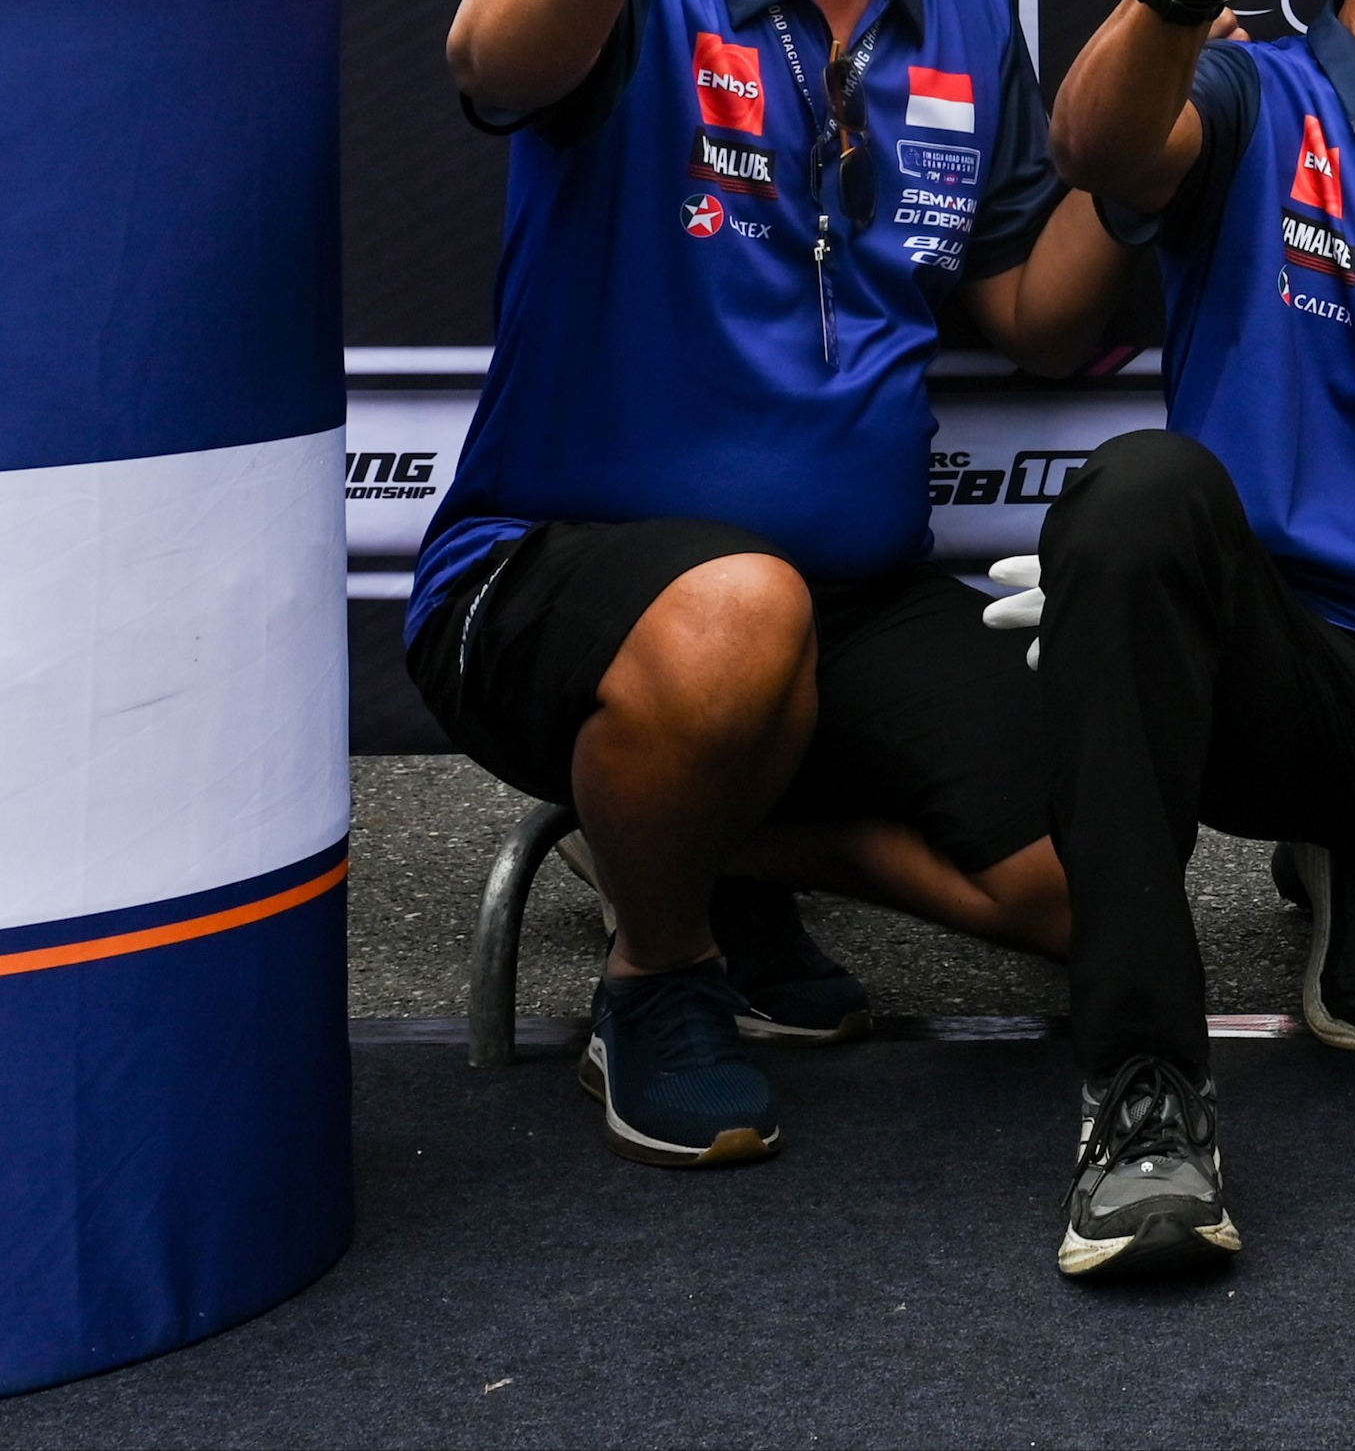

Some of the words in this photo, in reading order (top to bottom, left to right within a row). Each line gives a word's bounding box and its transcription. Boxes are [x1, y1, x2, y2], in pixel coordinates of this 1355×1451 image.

[781, 34, 805, 83] RACING
[903, 236, 964, 256] BLU
[910, 250, 961, 271] CRU
